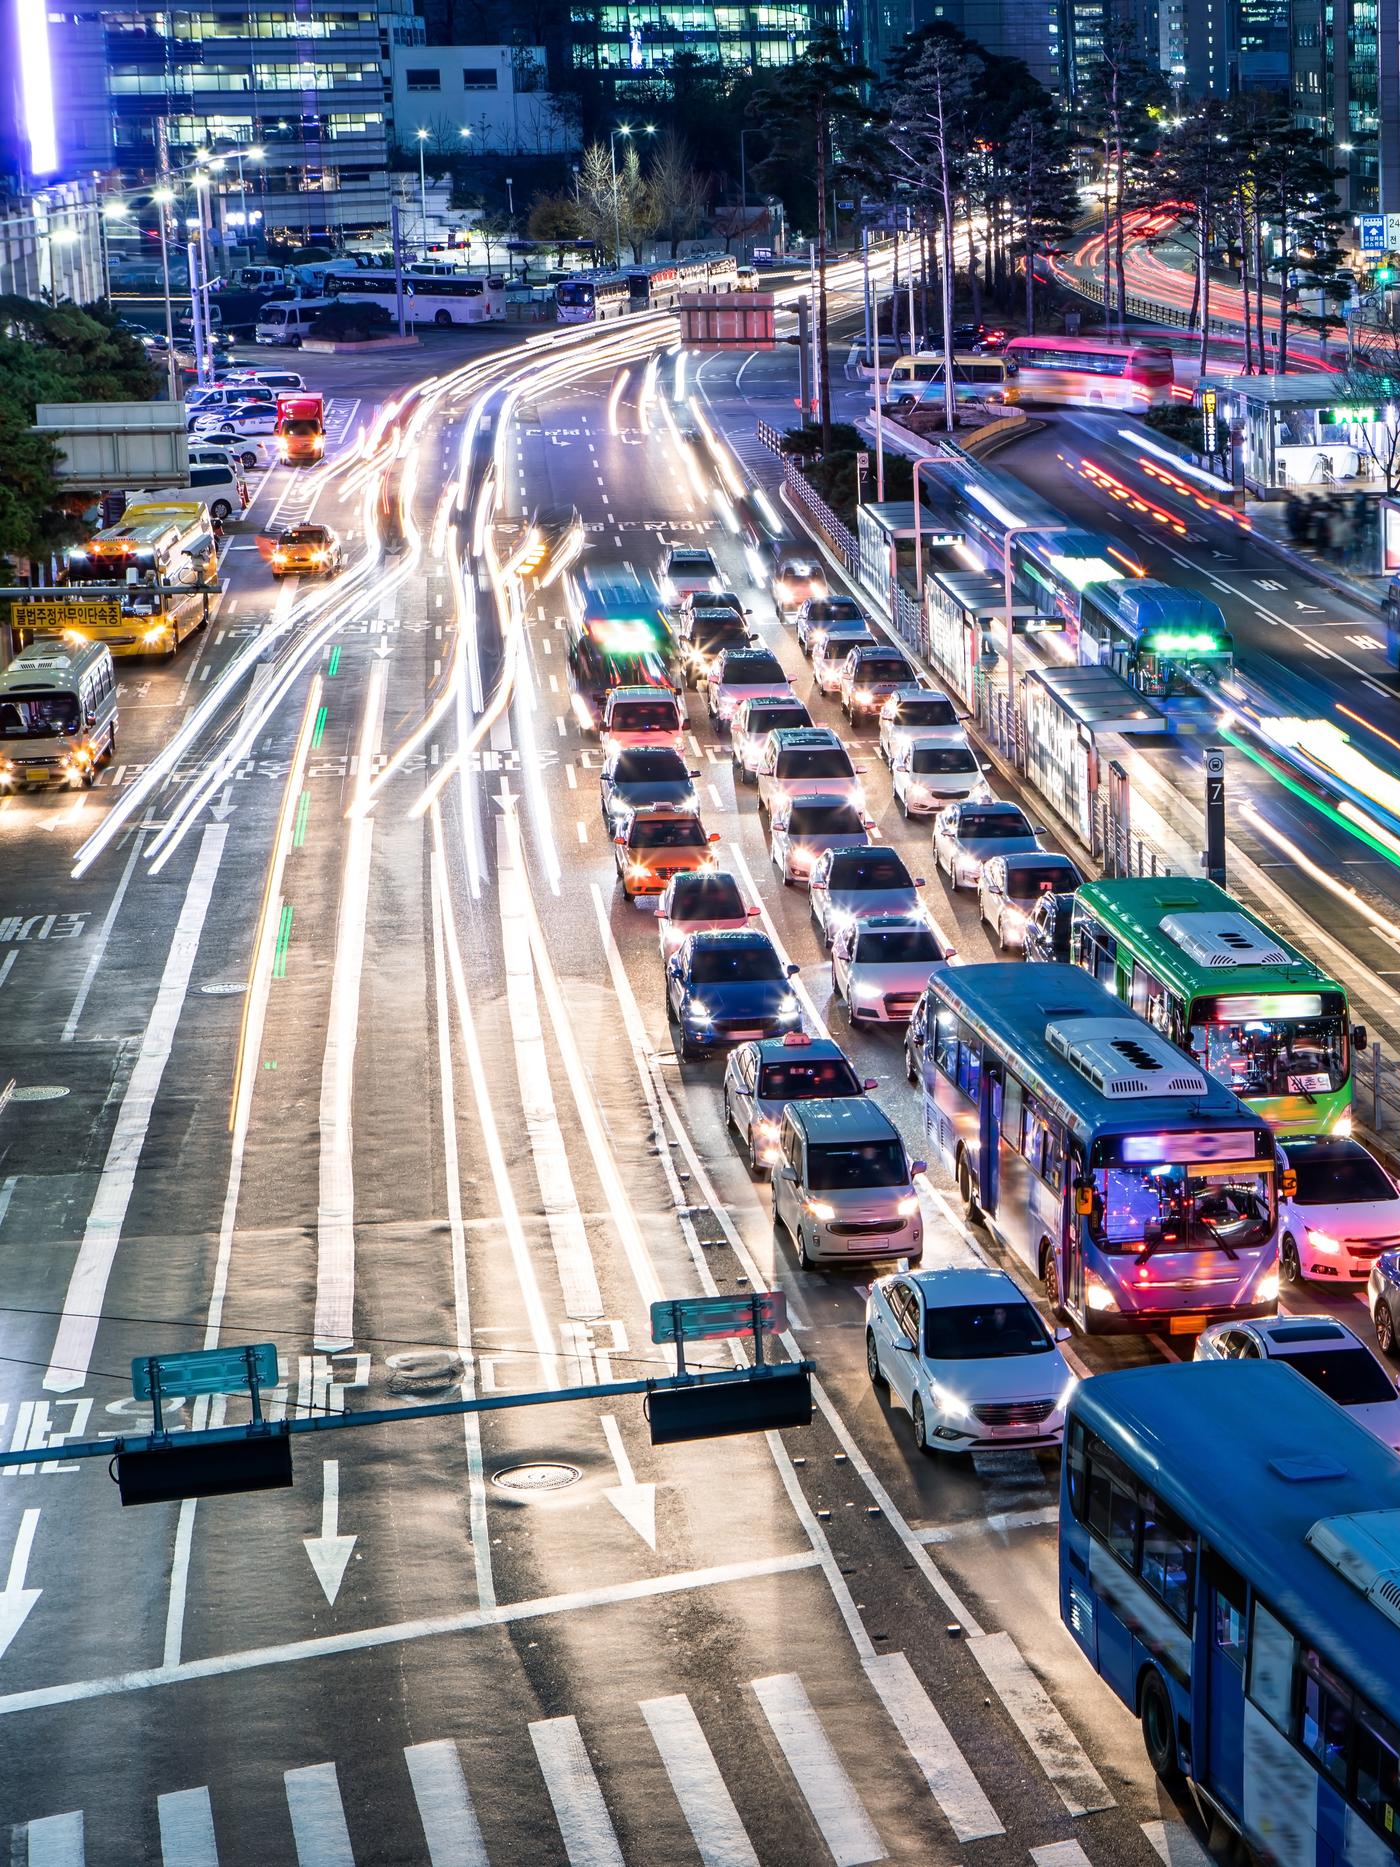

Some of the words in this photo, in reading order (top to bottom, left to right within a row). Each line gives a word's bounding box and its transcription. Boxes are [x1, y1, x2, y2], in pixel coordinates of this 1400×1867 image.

[861, 470, 868, 480] 7
[15, 607, 119, 626] 불법주정차무인단속중
[1211, 783, 1222, 800] 7
